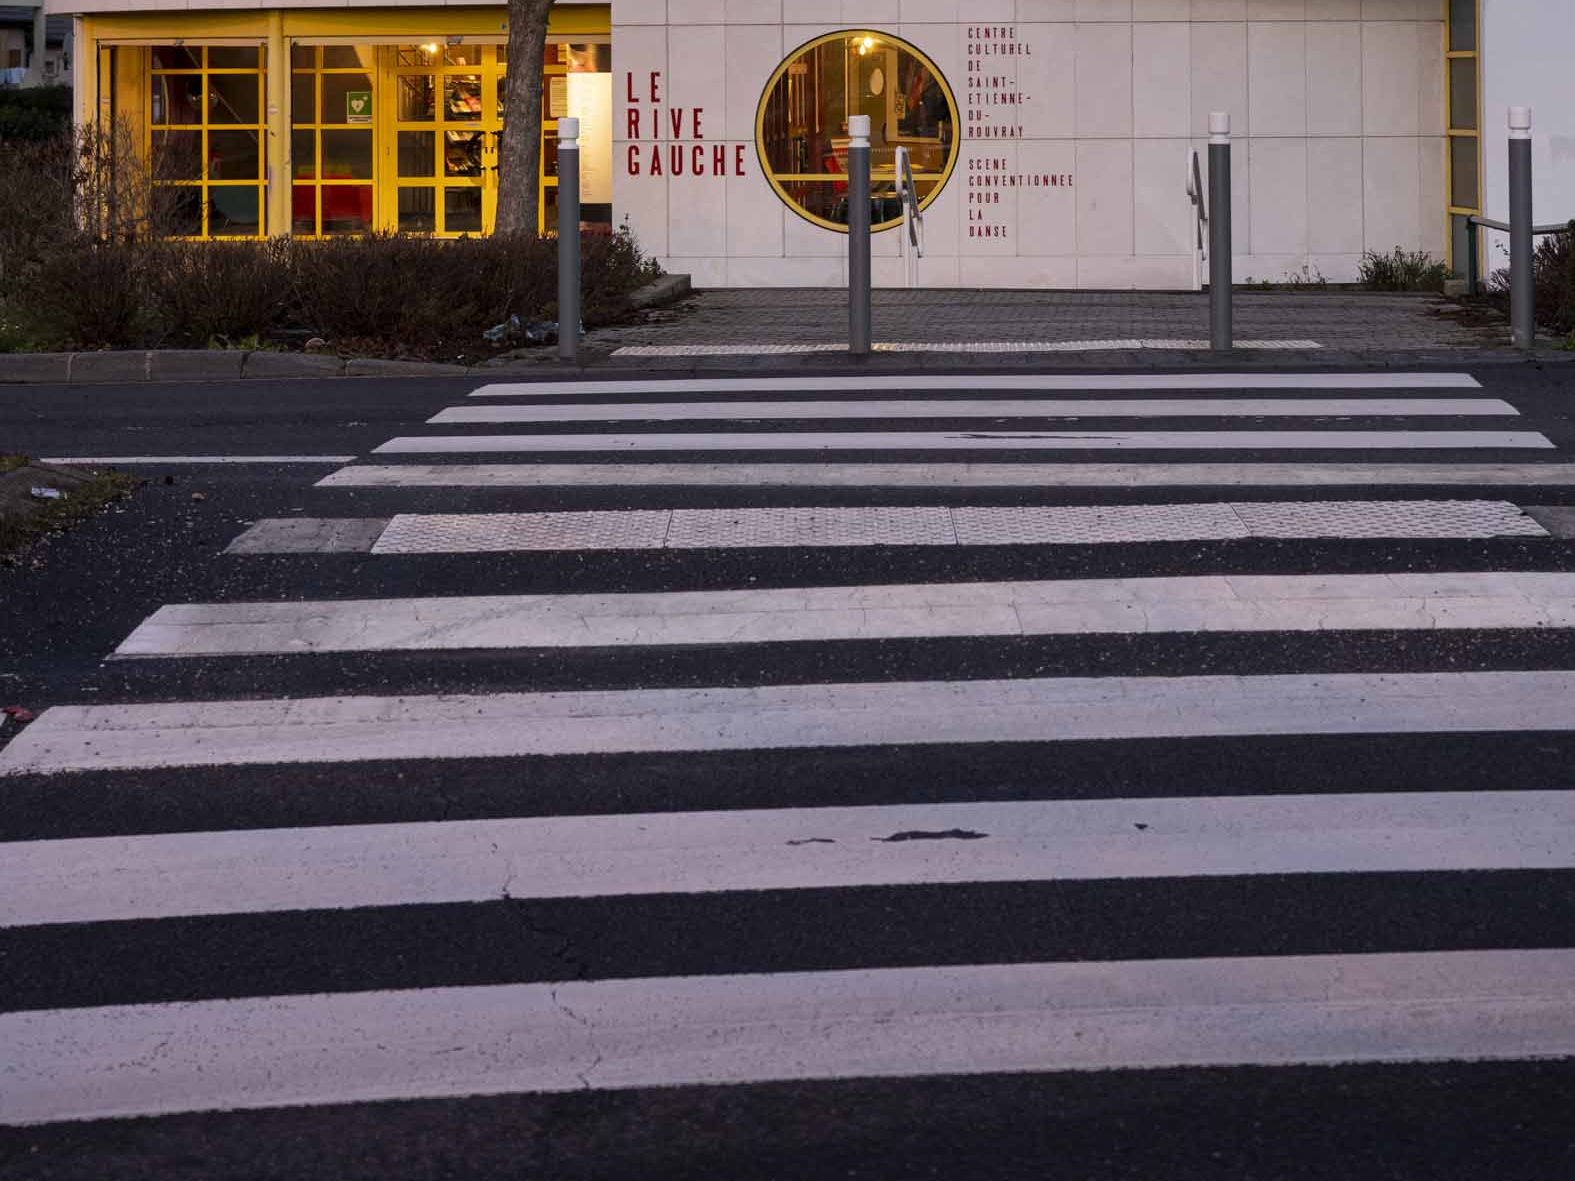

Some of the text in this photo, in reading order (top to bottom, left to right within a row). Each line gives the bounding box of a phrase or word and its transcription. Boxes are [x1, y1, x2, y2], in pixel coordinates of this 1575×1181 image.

[967, 27, 1015, 39] CENTRE
[967, 44, 1031, 55] CULTUREL
[967, 60, 981, 72] DE
[627, 72, 661, 103] LE
[967, 77, 1015, 88] SAINT-
[968, 93, 1031, 105] ETIENNE-
[968, 110, 990, 121] DU-
[627, 108, 704, 139] RIVE
[968, 126, 1023, 138] ROUVRAY
[627, 145, 746, 176] GAUCHE
[968, 158, 1007, 170] SCENE
[968, 174, 1073, 187] CONVENTIONNEE
[968, 192, 1000, 204] POUR
[968, 209, 983, 220] LA
[968, 226, 1007, 238] DANSE
